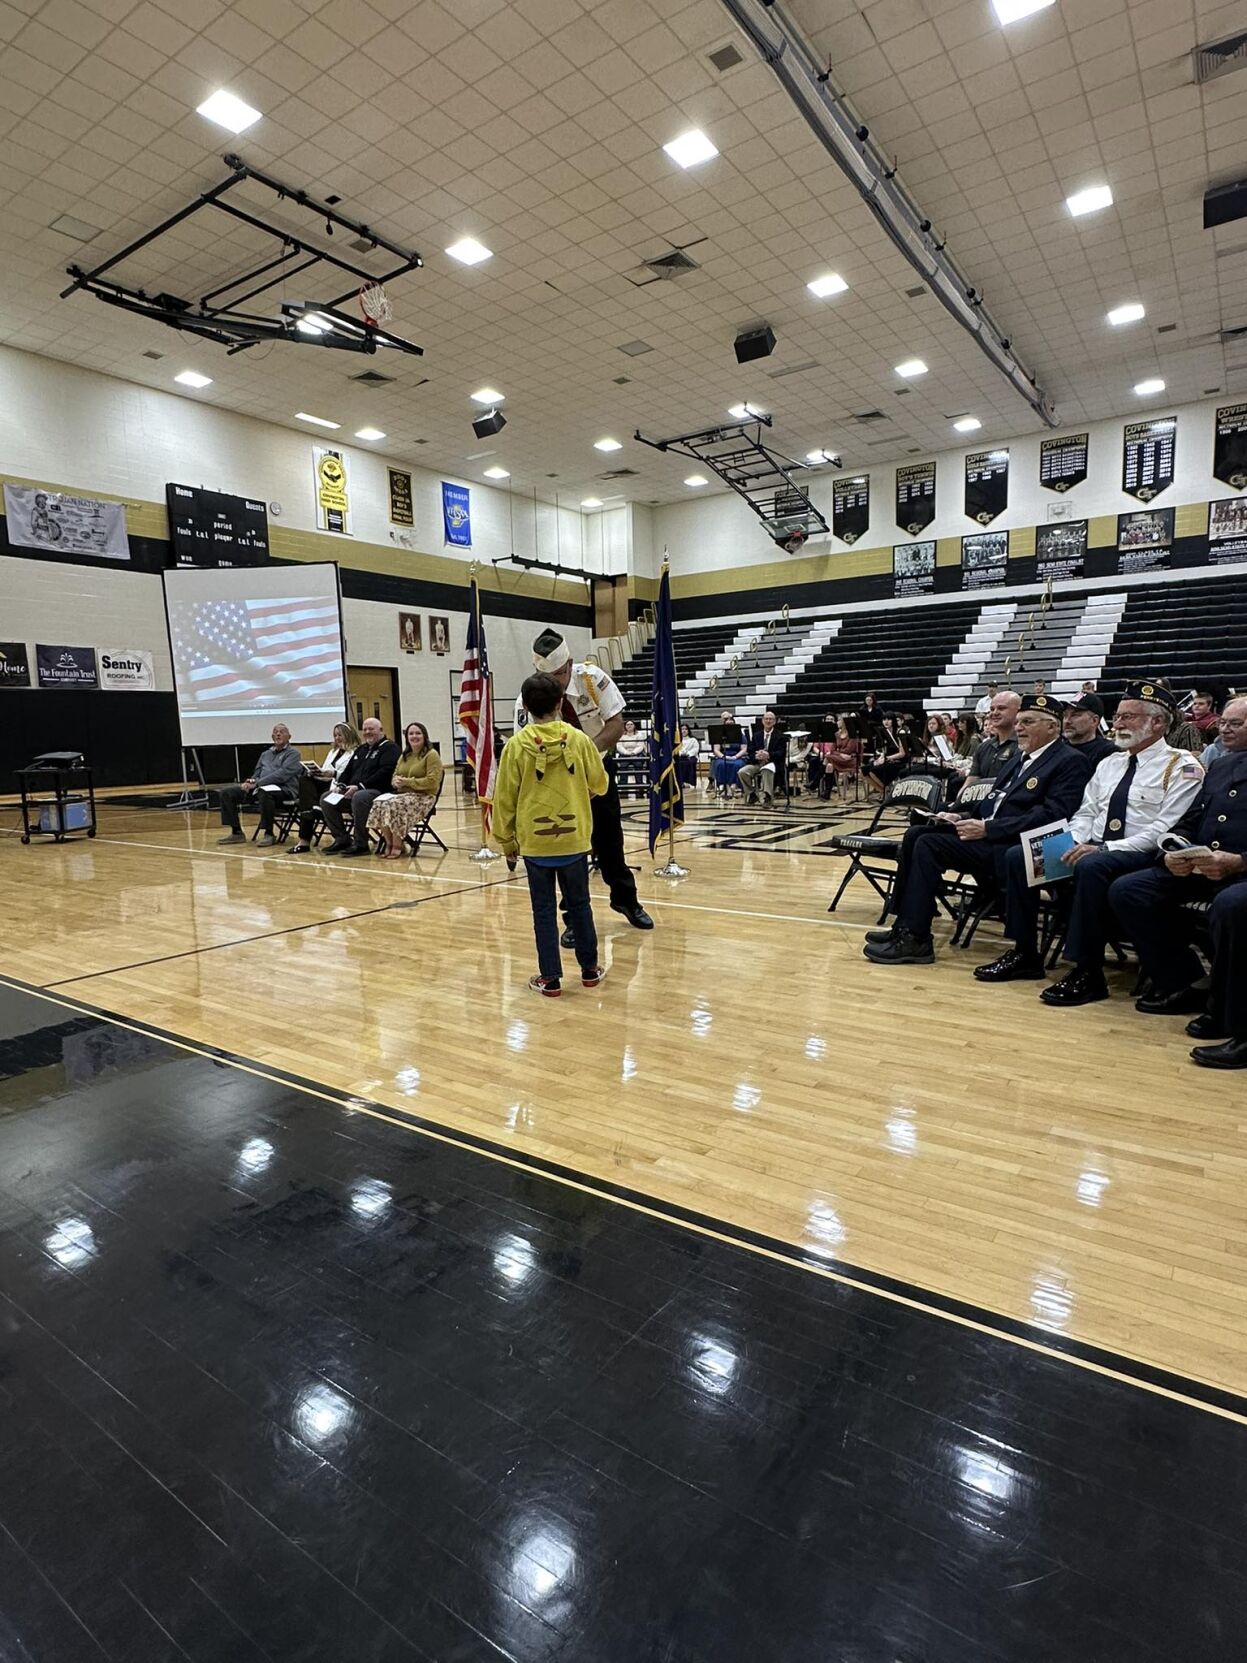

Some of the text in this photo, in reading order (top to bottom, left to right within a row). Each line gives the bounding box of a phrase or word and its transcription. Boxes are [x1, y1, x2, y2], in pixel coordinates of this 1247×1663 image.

[1042, 435, 1087, 450] COVINGTON
[176, 486, 193, 498] Home
[213, 522, 232, 531] period
[177, 526, 191, 536] fouls
[214, 533, 233, 542] player
[101, 655, 142, 672] Sentry
[40, 667, 96, 679] The Fountain Trust
